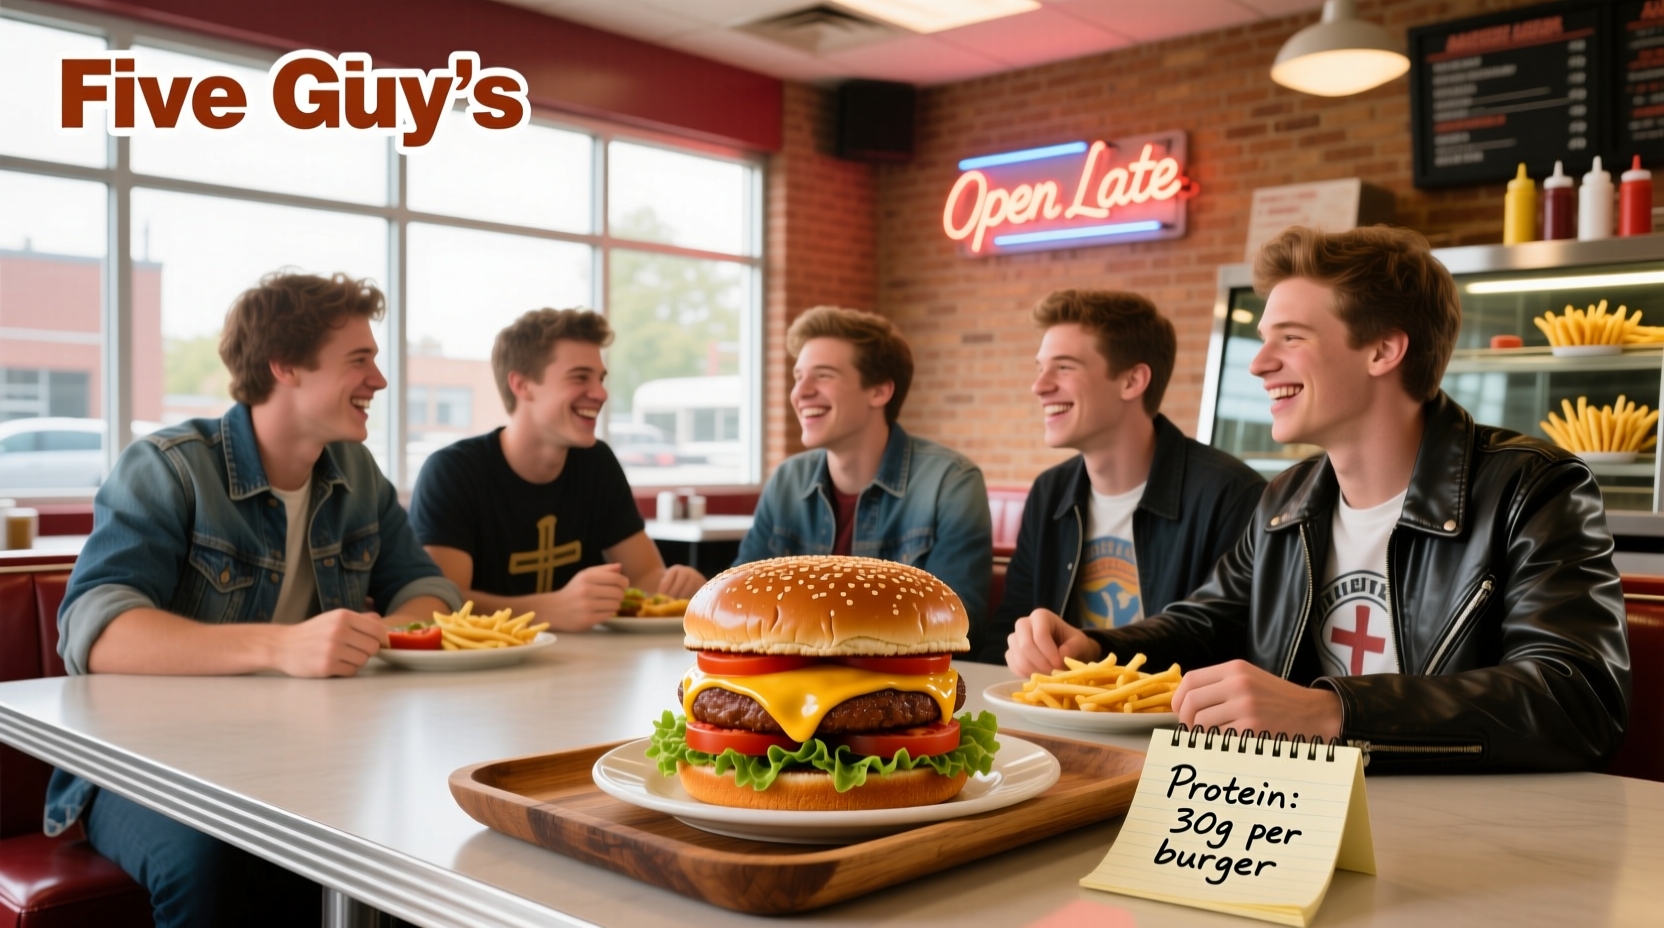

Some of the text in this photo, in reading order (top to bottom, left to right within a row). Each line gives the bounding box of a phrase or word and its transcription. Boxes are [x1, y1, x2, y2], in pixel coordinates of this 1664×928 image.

[943, 140, 1182, 253] Open Late
[1166, 763, 1299, 809] Protein:
[1169, 807, 1303, 851] 30g per
[1153, 838, 1277, 885] burger
